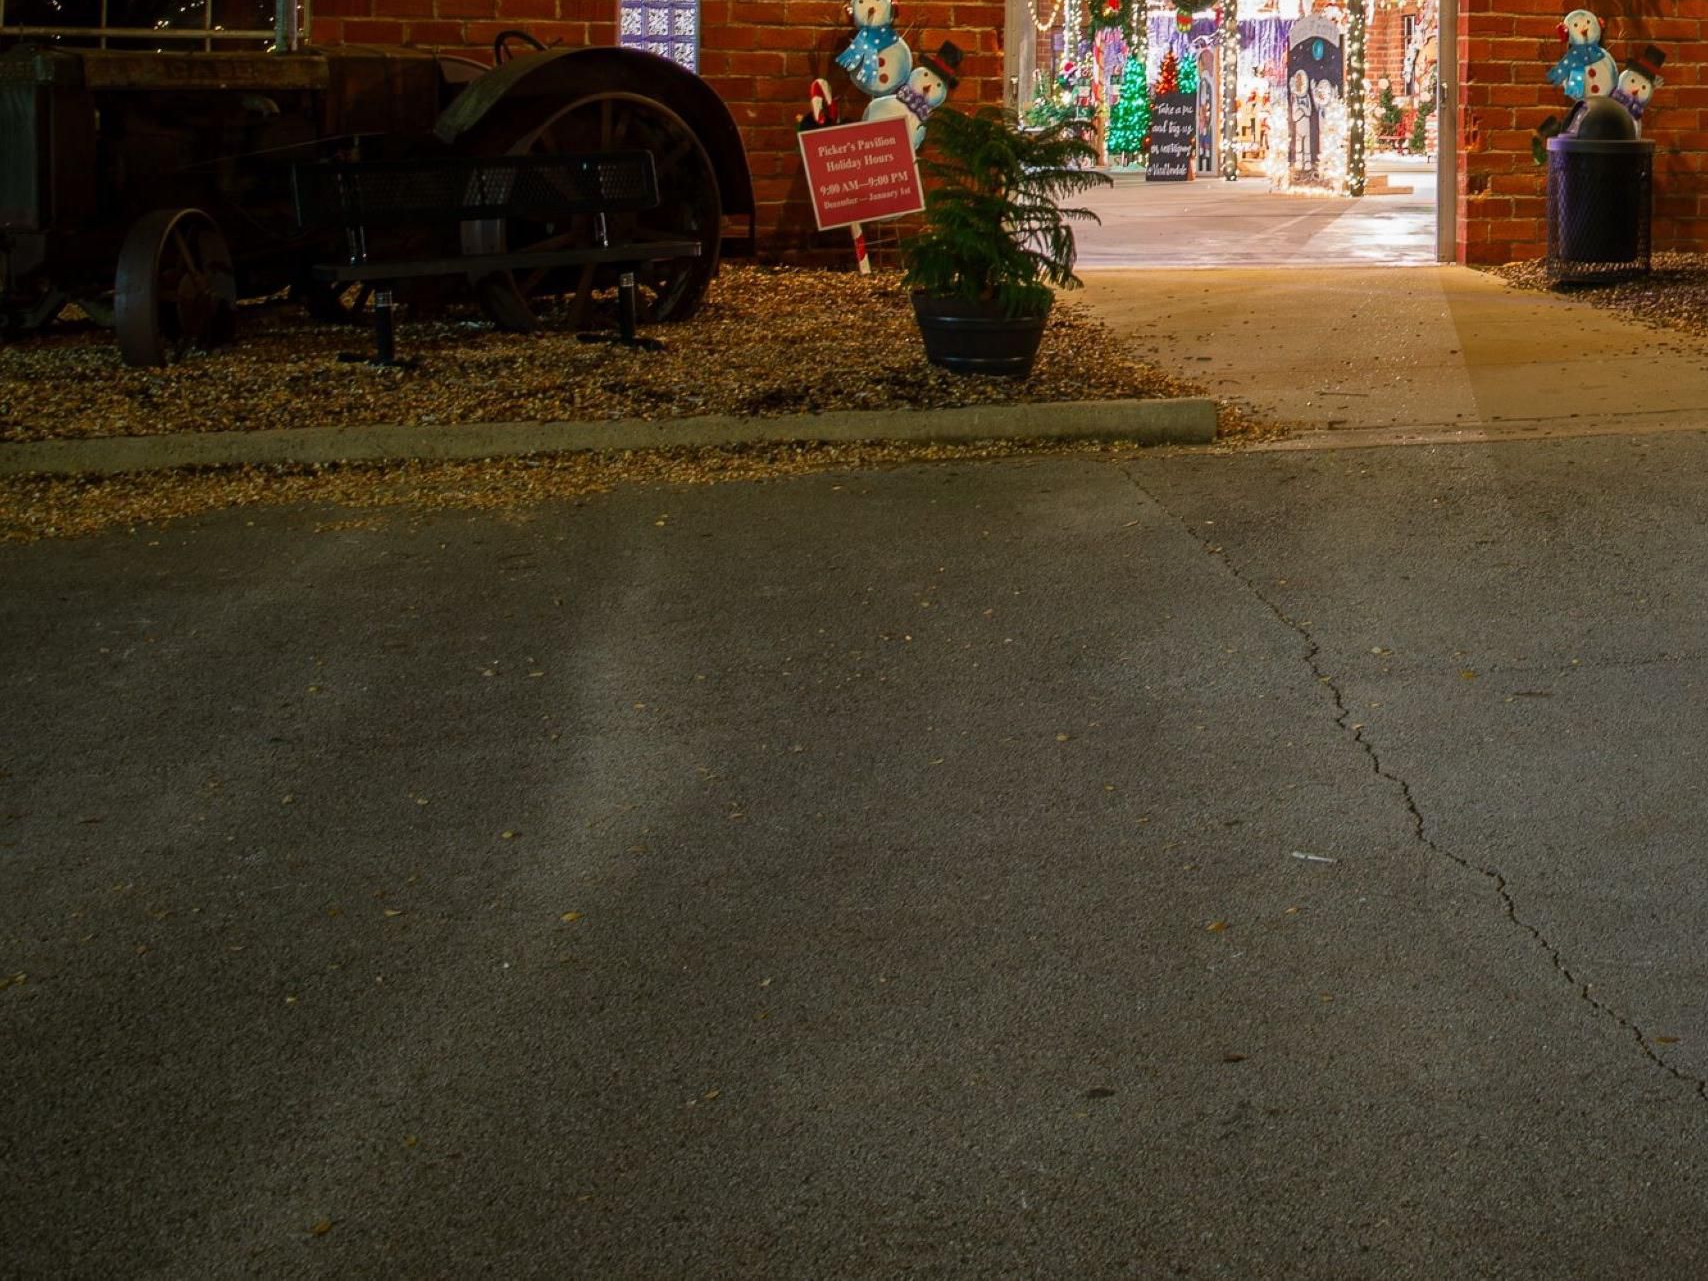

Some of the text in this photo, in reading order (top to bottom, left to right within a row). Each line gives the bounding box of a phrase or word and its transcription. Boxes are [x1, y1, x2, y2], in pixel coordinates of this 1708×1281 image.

[818, 136, 896, 157] Picker's Pavilion
[826, 153, 894, 172] Holiday Hours
[891, 171, 908, 183] PM
